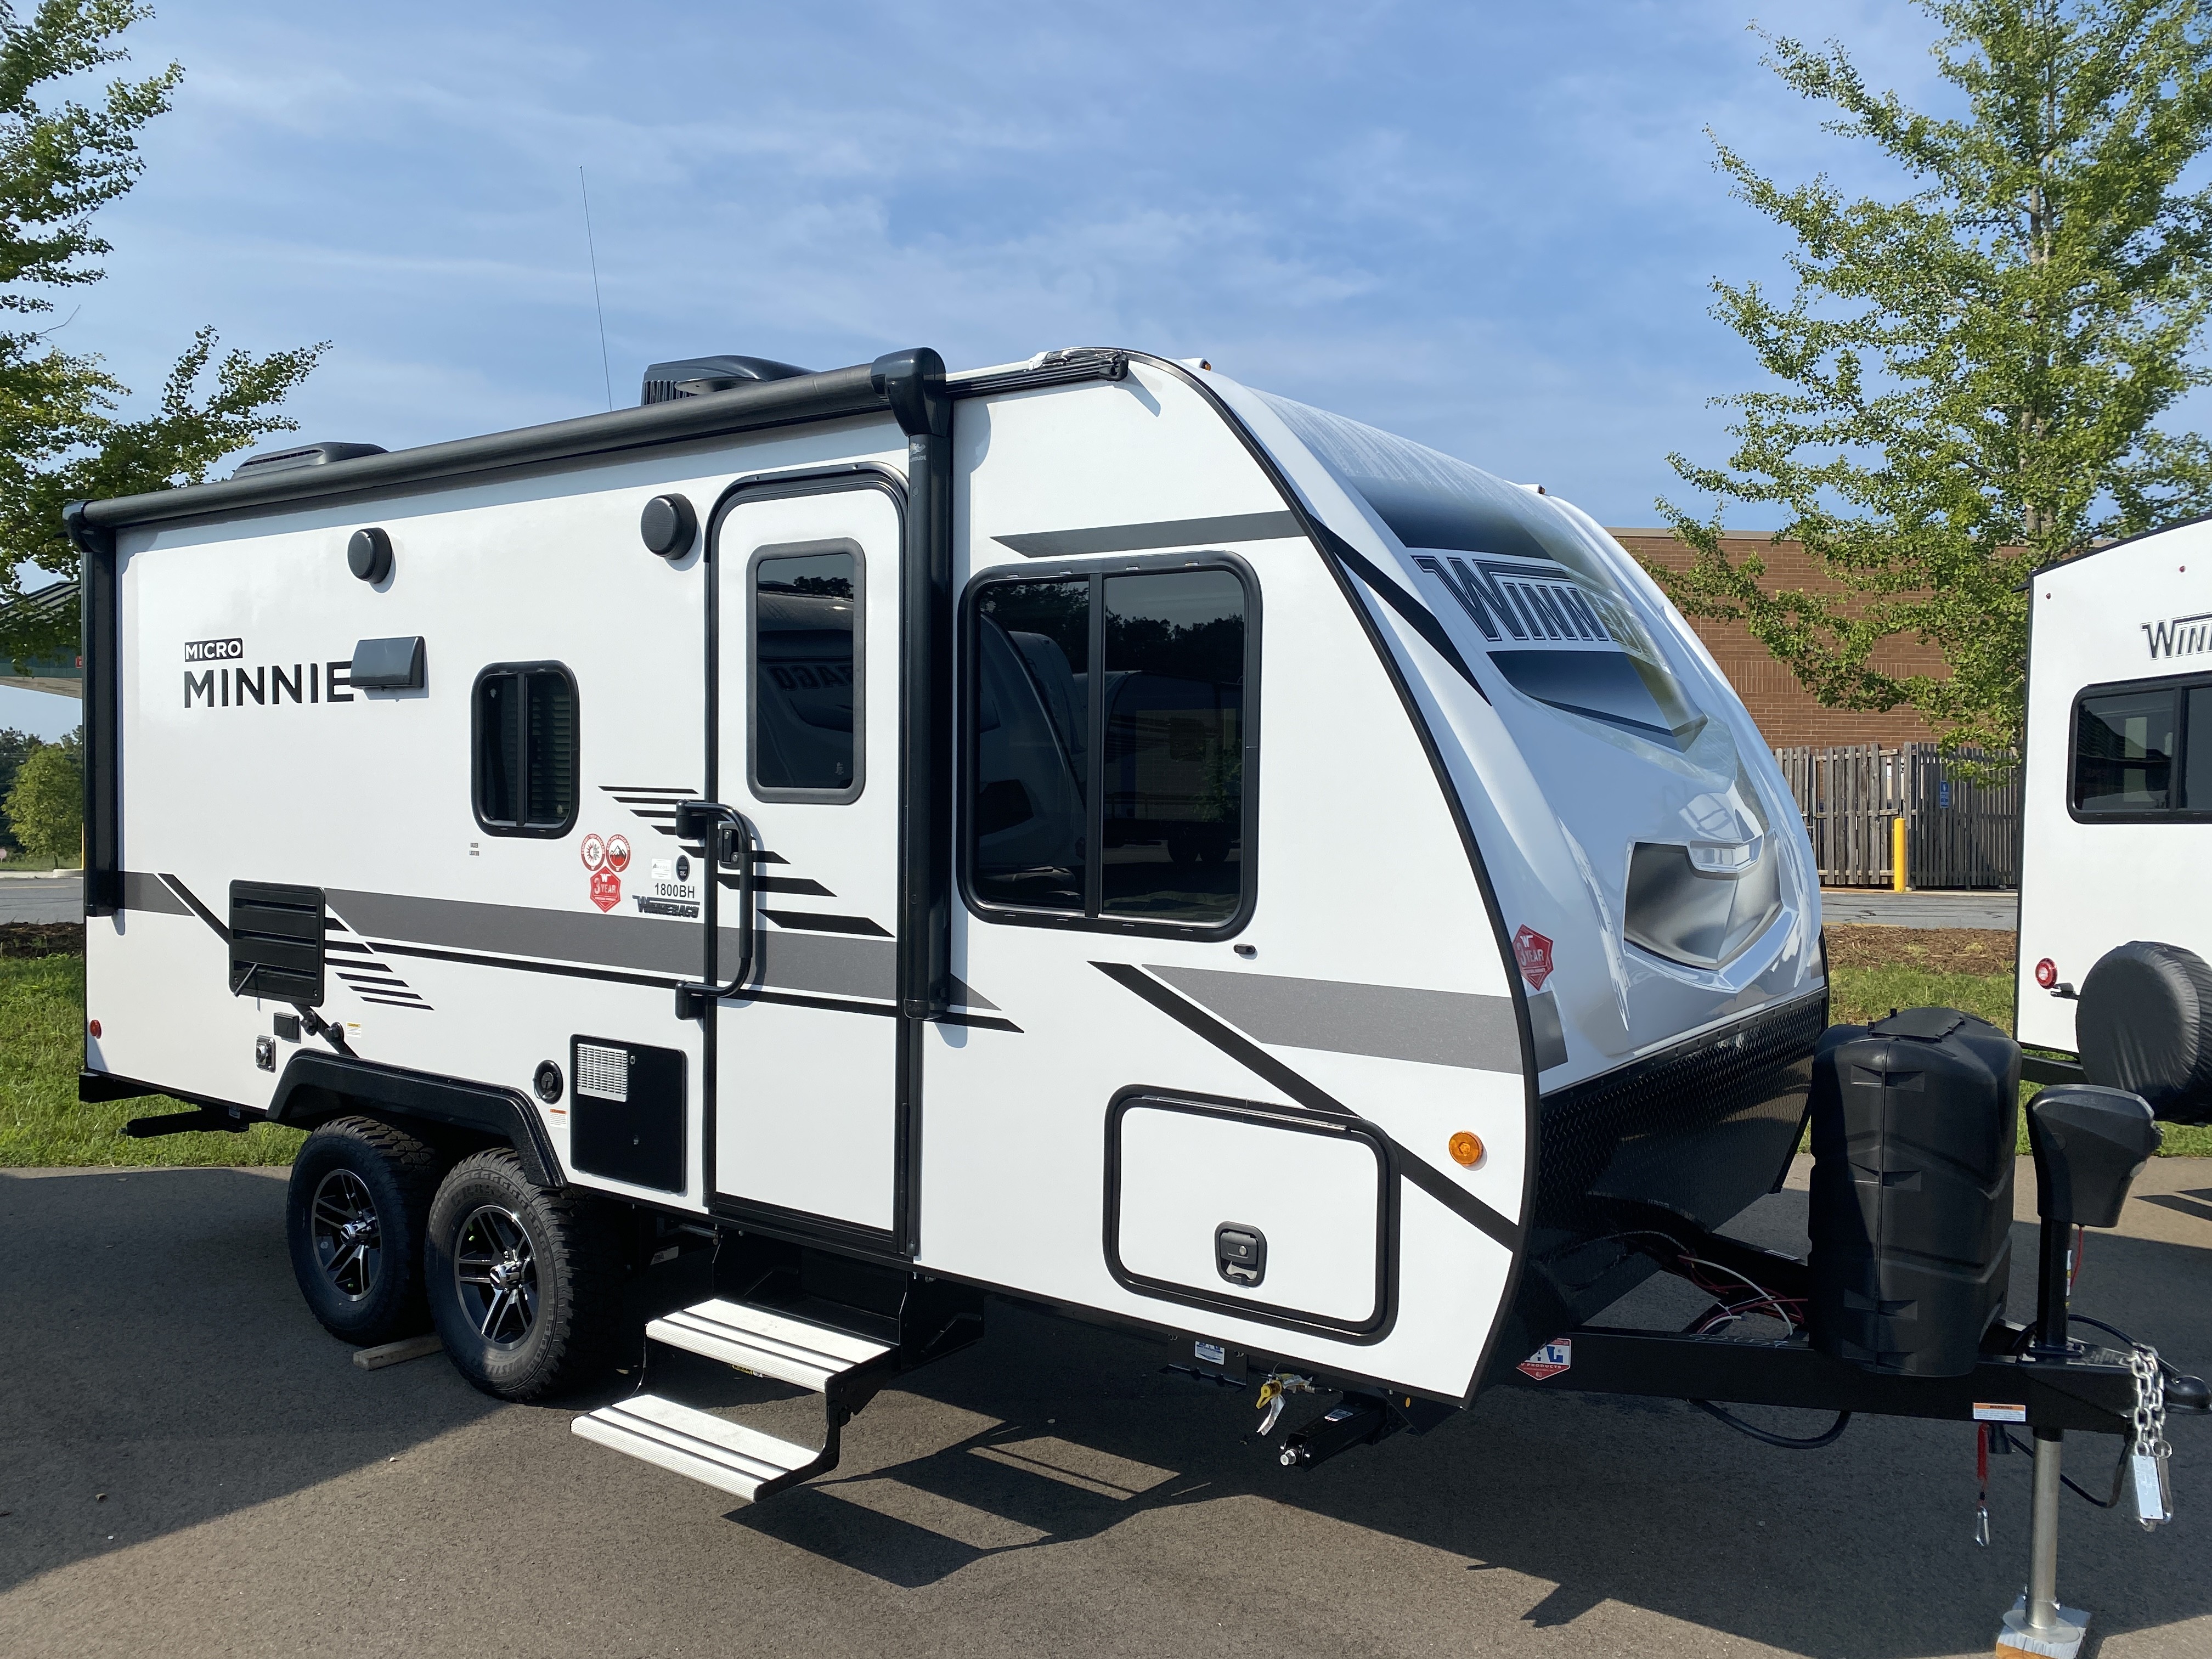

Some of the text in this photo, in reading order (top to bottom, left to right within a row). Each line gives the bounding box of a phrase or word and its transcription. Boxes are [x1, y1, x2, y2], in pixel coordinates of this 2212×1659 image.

[185, 640, 242, 660] MICRO
[184, 661, 354, 708] MINNIE
[594, 877, 616, 894] 3 YEAR
[654, 883, 695, 898] 1800BH
[1516, 942, 1544, 966] 3 YEAR
